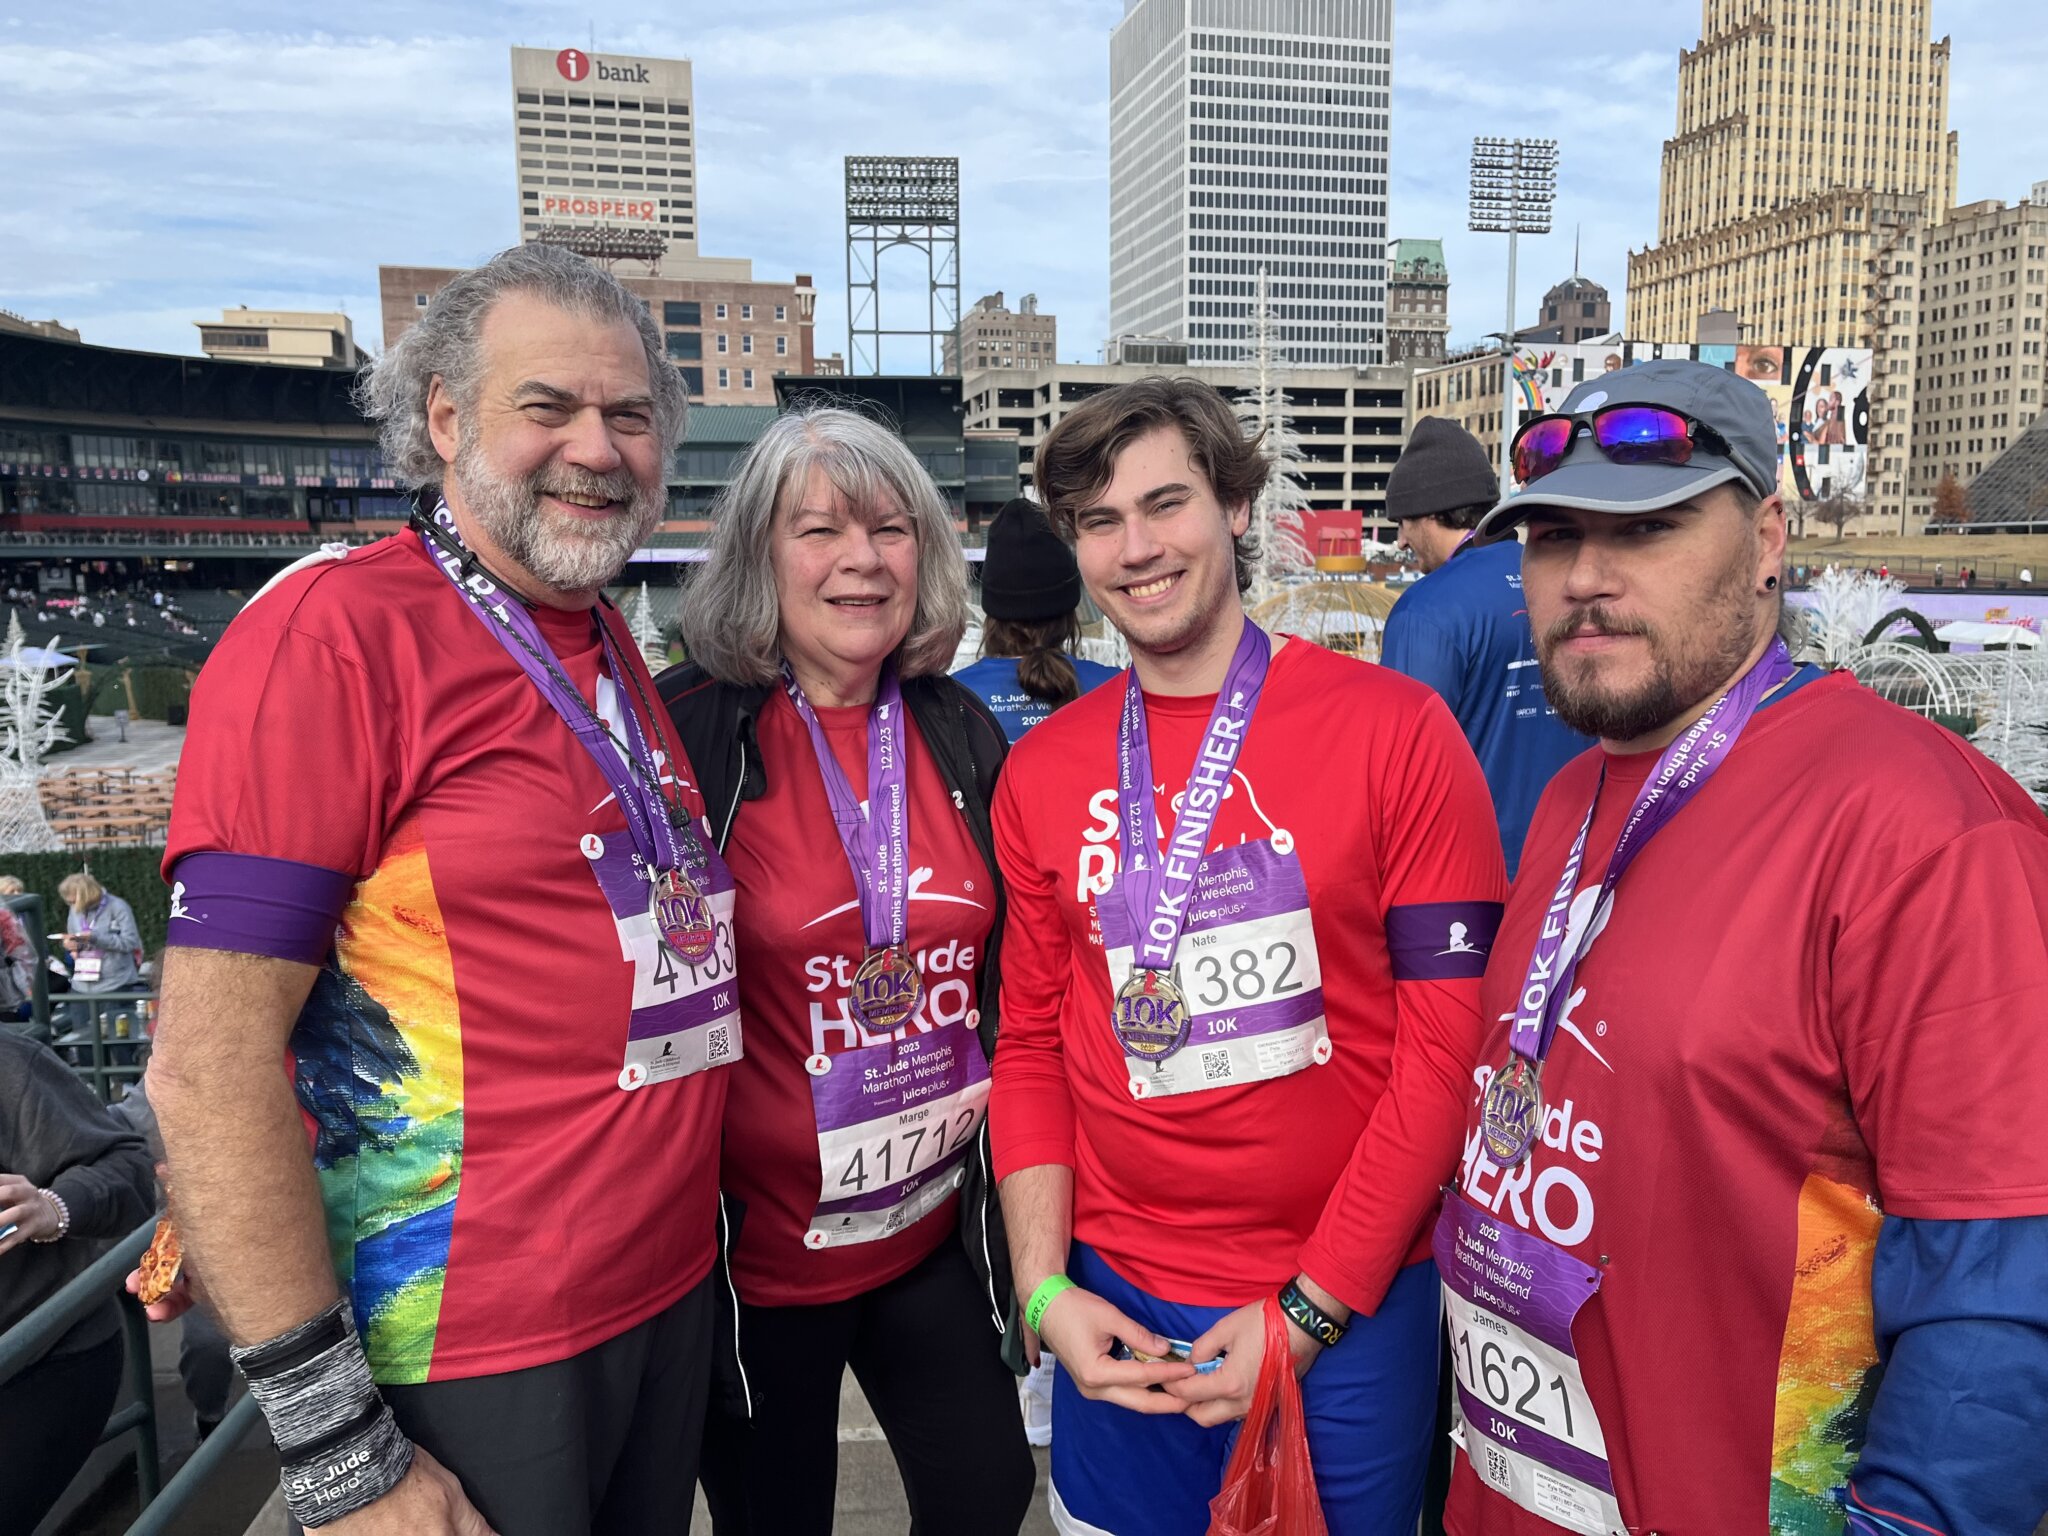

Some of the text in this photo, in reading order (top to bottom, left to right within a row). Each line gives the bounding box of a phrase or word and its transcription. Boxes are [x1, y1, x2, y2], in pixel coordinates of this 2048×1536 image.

[596, 61, 650, 83] bank
[988, 703, 1034, 712] Marathon
[990, 694, 1031, 703] St. Jude
[1021, 716, 1049, 726] 202
[1132, 705, 1140, 731] Jude
[880, 727, 893, 770] 12.2.23
[1659, 716, 1713, 786] Marathon
[1678, 730, 1727, 790] St. Jude
[1121, 739, 1132, 790] Weekend
[889, 784, 901, 837] Weekend
[1165, 716, 1246, 881] FINISHER
[1129, 801, 1144, 846] 12.2.23
[877, 844, 888, 893] St. Jude
[891, 838, 902, 898] Marathon
[1199, 867, 1248, 888] Memphis
[1201, 879, 1254, 901] Weekend
[658, 896, 706, 925] 10K
[1144, 888, 1187, 962] 10K
[1192, 935, 1217, 948] Nate
[805, 954, 852, 992] St
[858, 969, 915, 1000] 10K
[1176, 941, 1303, 1007] 382
[712, 990, 730, 1011] 10K
[1517, 950, 1556, 1034] 10K
[1119, 996, 1181, 1027] 10K
[1207, 1017, 1238, 1036] 10K
[864, 1046, 952, 1080] St. Jude Memphis
[898, 1041, 920, 1055] 2023
[862, 1056, 955, 1095] Marathon Weekend
[899, 1108, 930, 1125] Marge
[1493, 1083, 1537, 1130] 10K
[839, 1108, 975, 1191] 41712
[1488, 1124, 1518, 1150] MEMPHIS
[900, 1175, 921, 1197] 10K
[1479, 1222, 1501, 1242] 2023
[1464, 1233, 1485, 1256] Jude
[1485, 1245, 1535, 1281] Memphis
[1485, 1264, 1532, 1300] Weekend
[1038, 1294, 1048, 1307] 21
[1472, 1309, 1508, 1336] James
[1489, 1417, 1517, 1444] 10K
[292, 1450, 371, 1495] St. Jude
[314, 1477, 360, 1506] Hero
